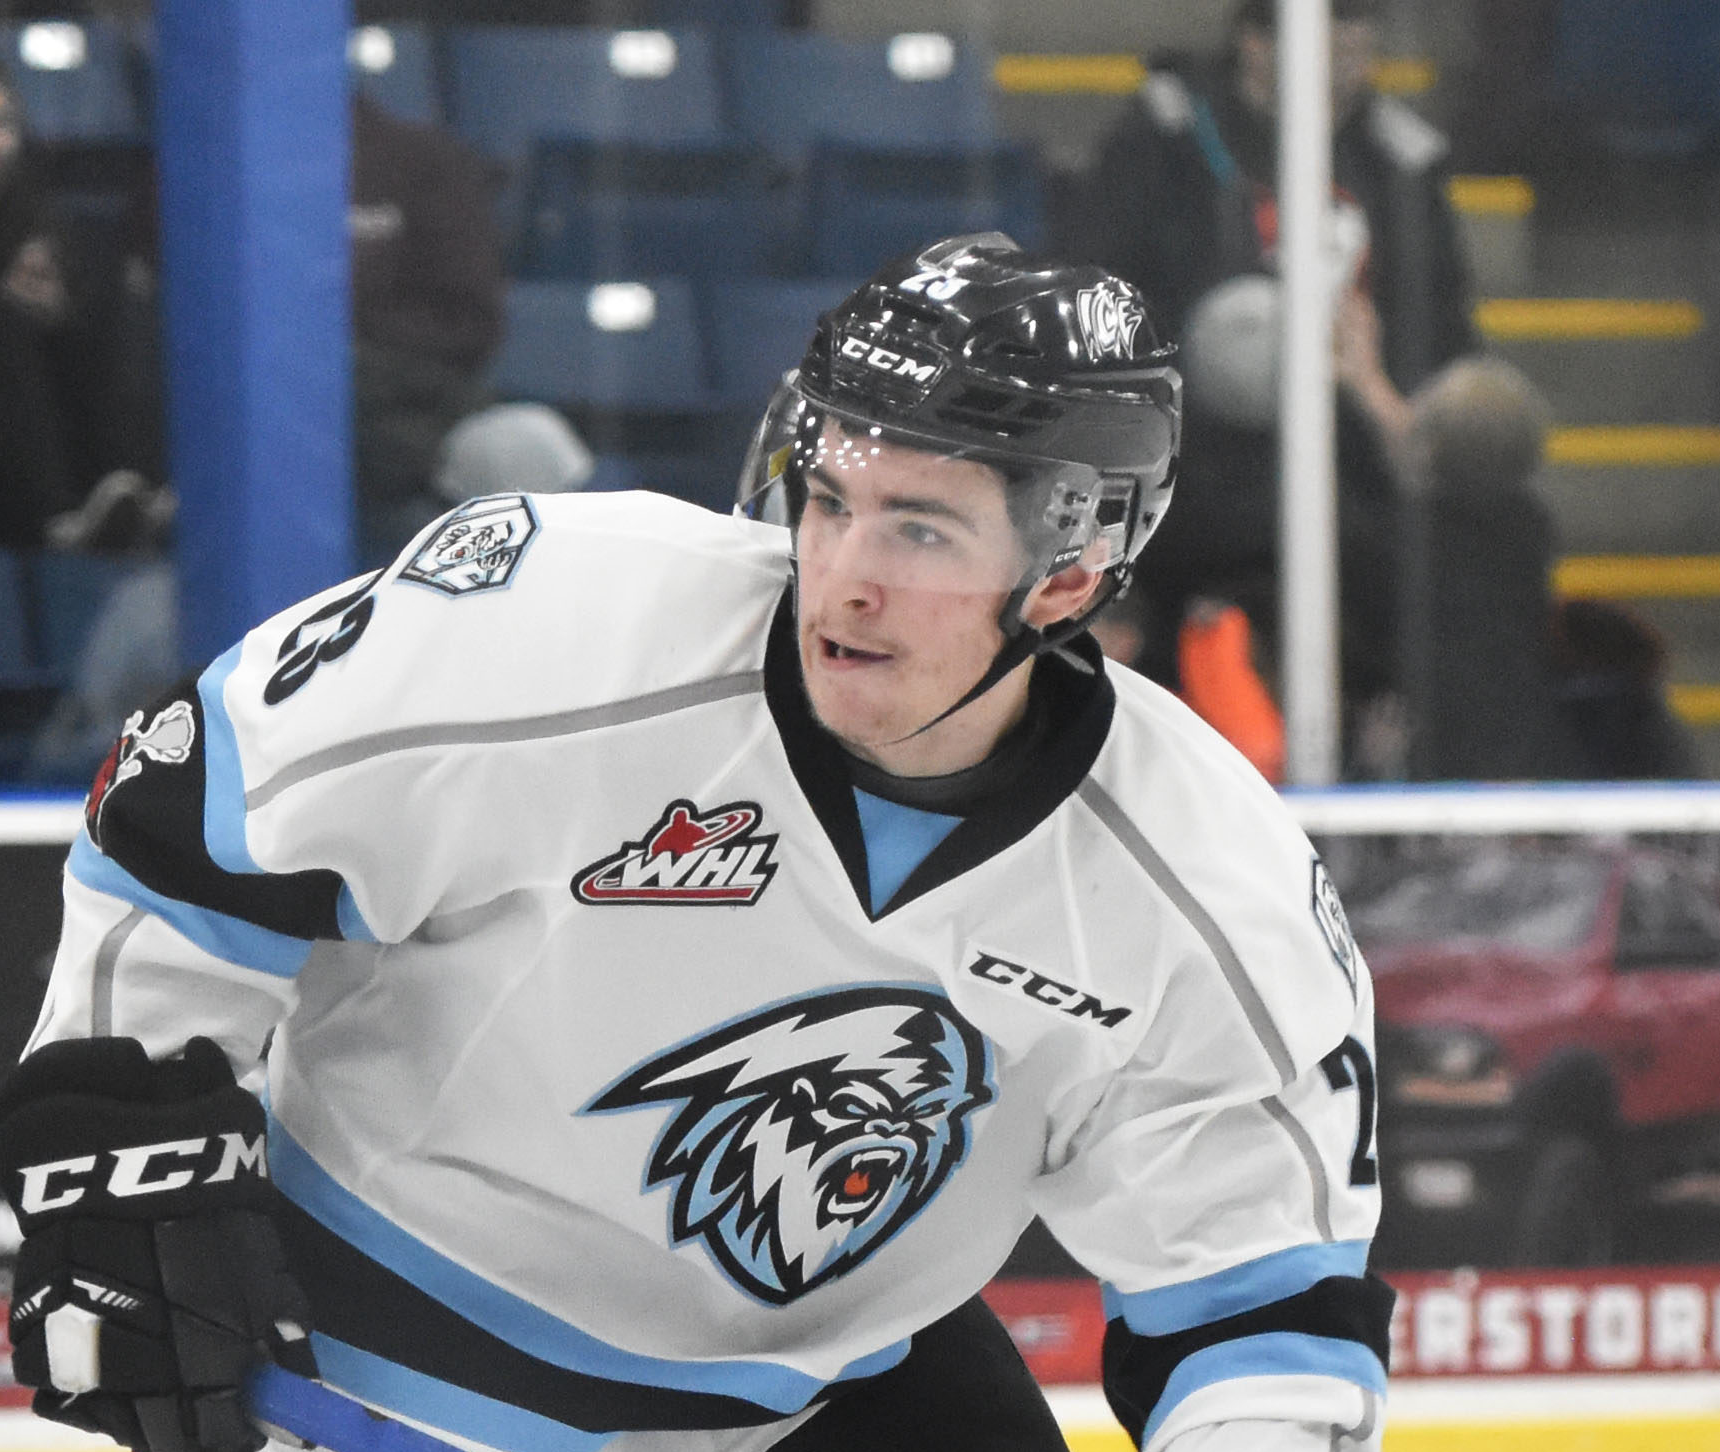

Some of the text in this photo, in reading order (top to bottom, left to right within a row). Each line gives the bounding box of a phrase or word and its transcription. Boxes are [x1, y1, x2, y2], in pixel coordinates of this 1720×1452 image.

[1076, 280, 1143, 361] ICE
[841, 336, 937, 382] CCM
[1054, 549, 1082, 563] CCM
[619, 841, 773, 887] WHL
[969, 949, 1133, 1029] CCM
[17, 1131, 269, 1215] CCM
